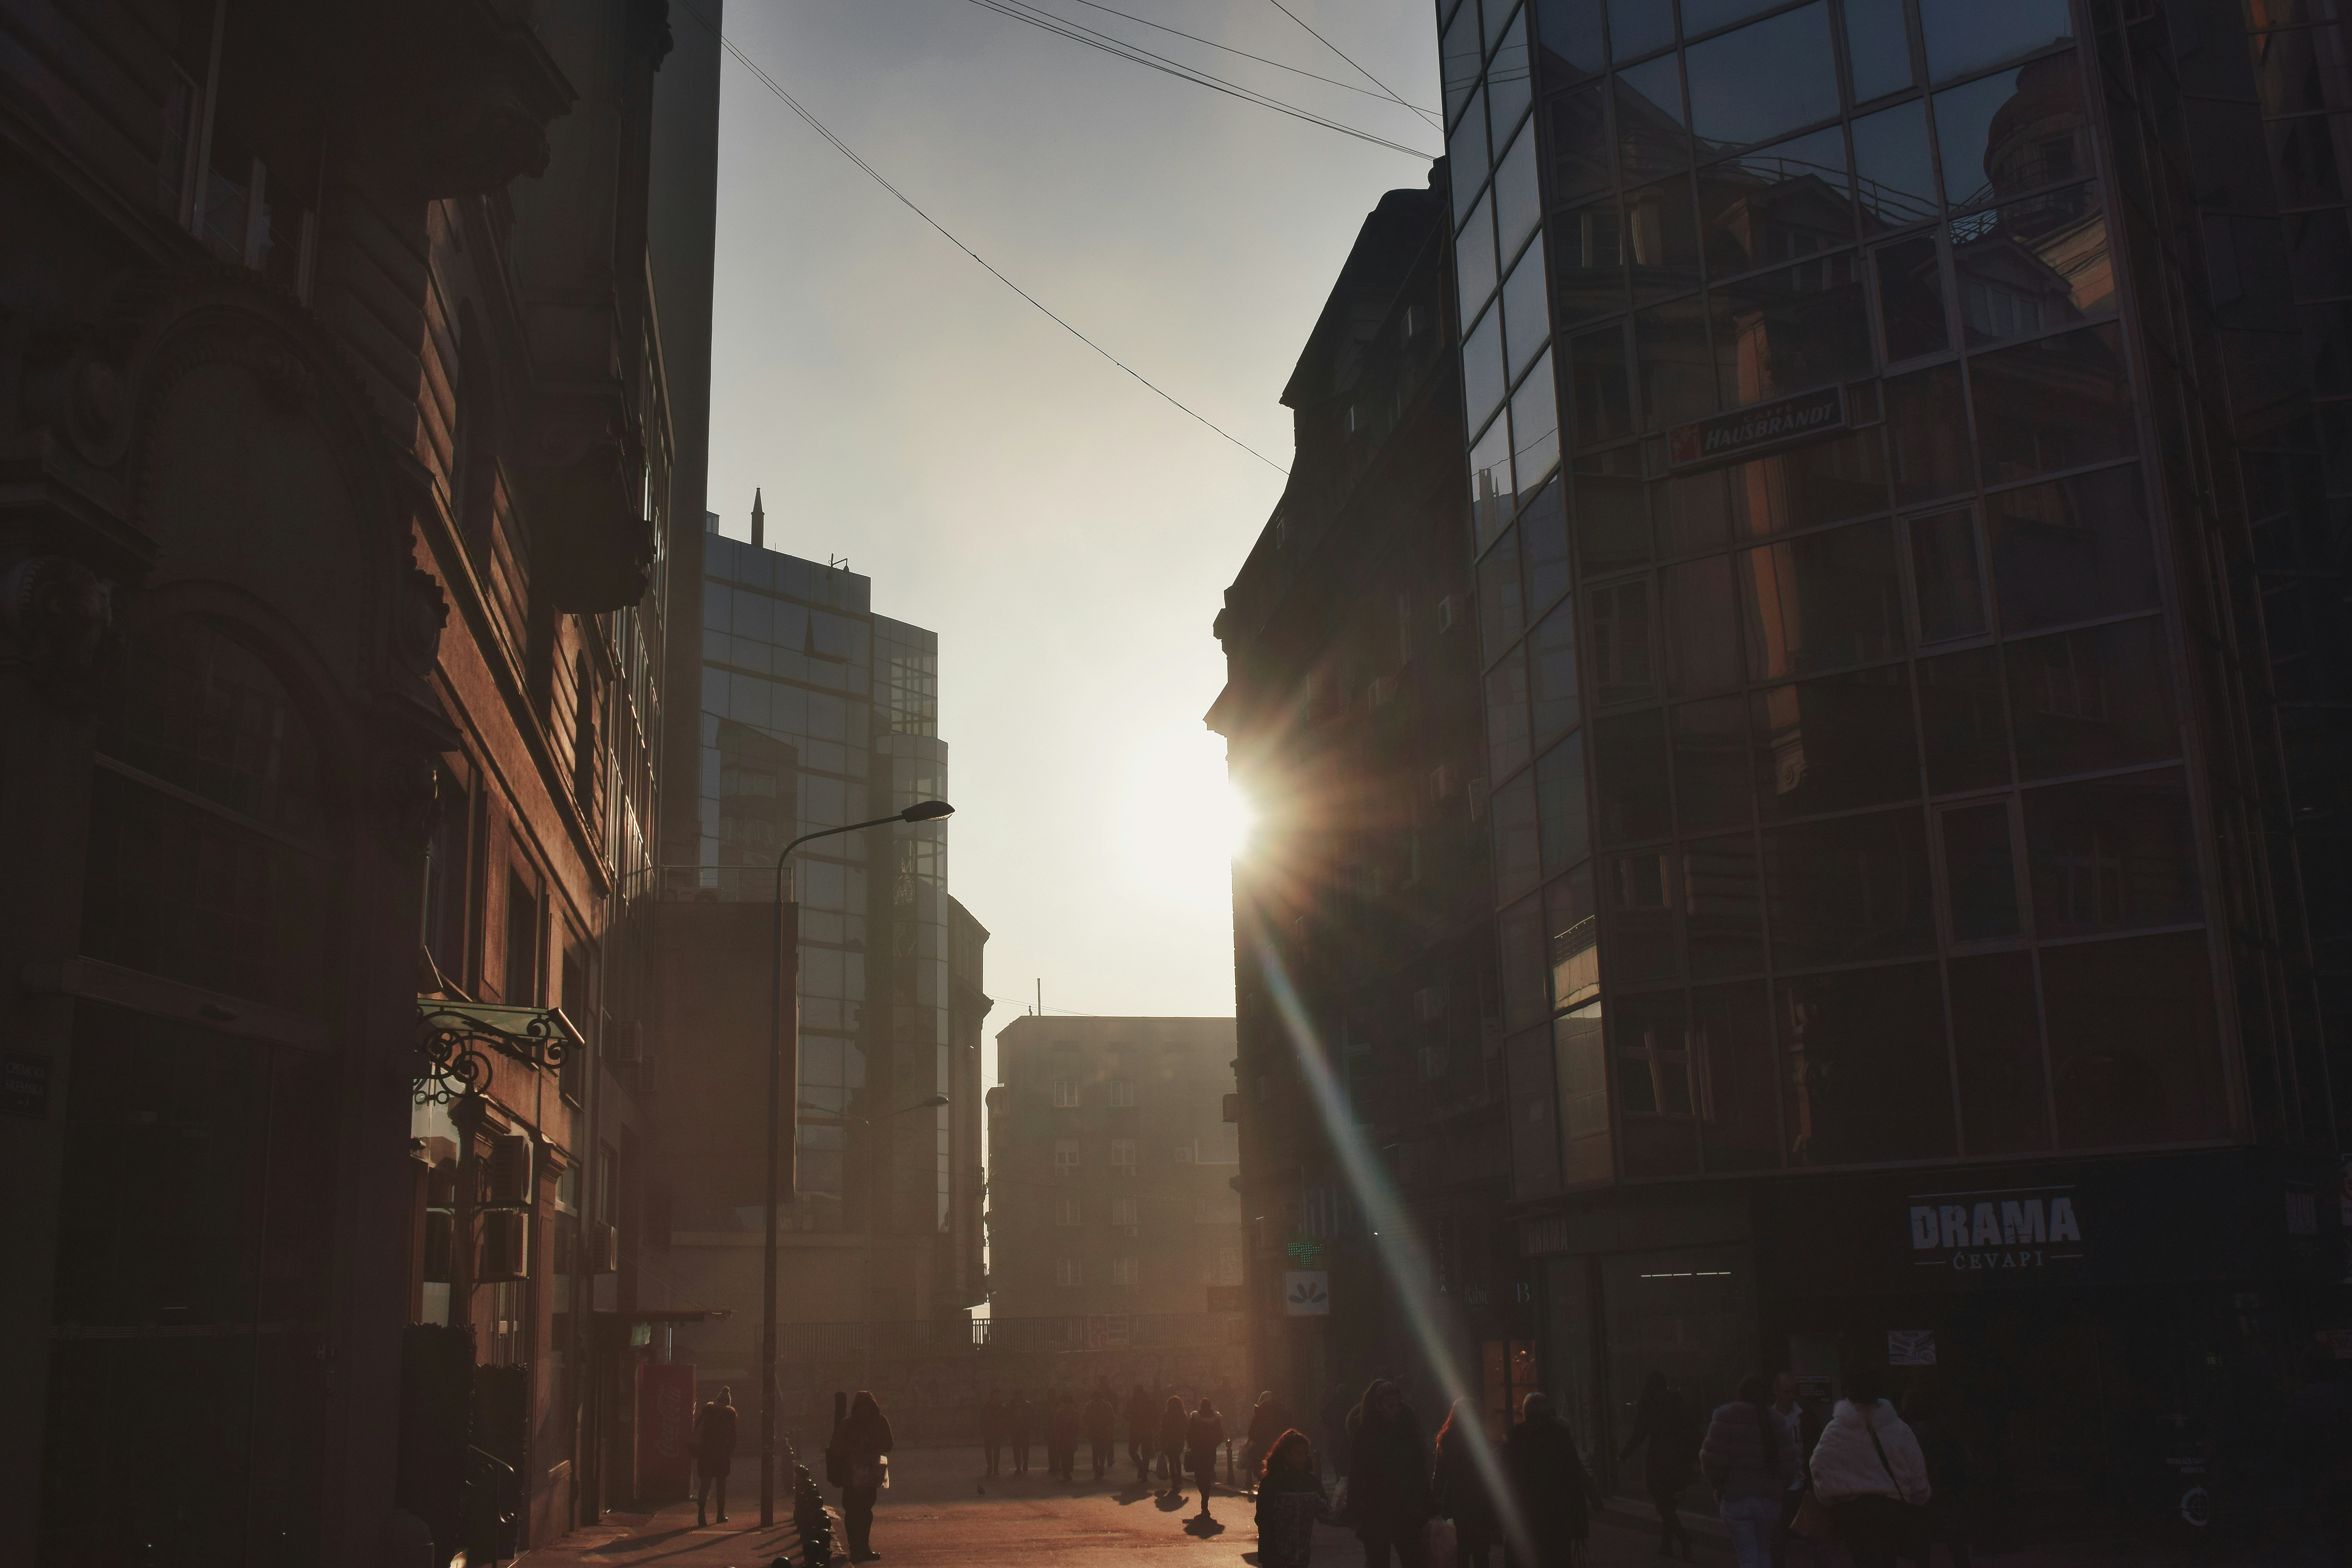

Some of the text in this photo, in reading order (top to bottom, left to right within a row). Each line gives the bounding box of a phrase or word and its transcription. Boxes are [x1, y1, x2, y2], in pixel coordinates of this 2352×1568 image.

[1705, 403, 1835, 451] HAUSBRANDT
[7, 1062, 45, 1079] СРЕМСКА
[5, 1079, 44, 1096] SREMSKA
[1910, 1197, 2081, 1249] DRAMA
[1437, 1221, 1447, 1293] ZLATARA
[1953, 1251, 2043, 1269] ĆEVAPI
[1517, 1283, 1530, 1303] B
